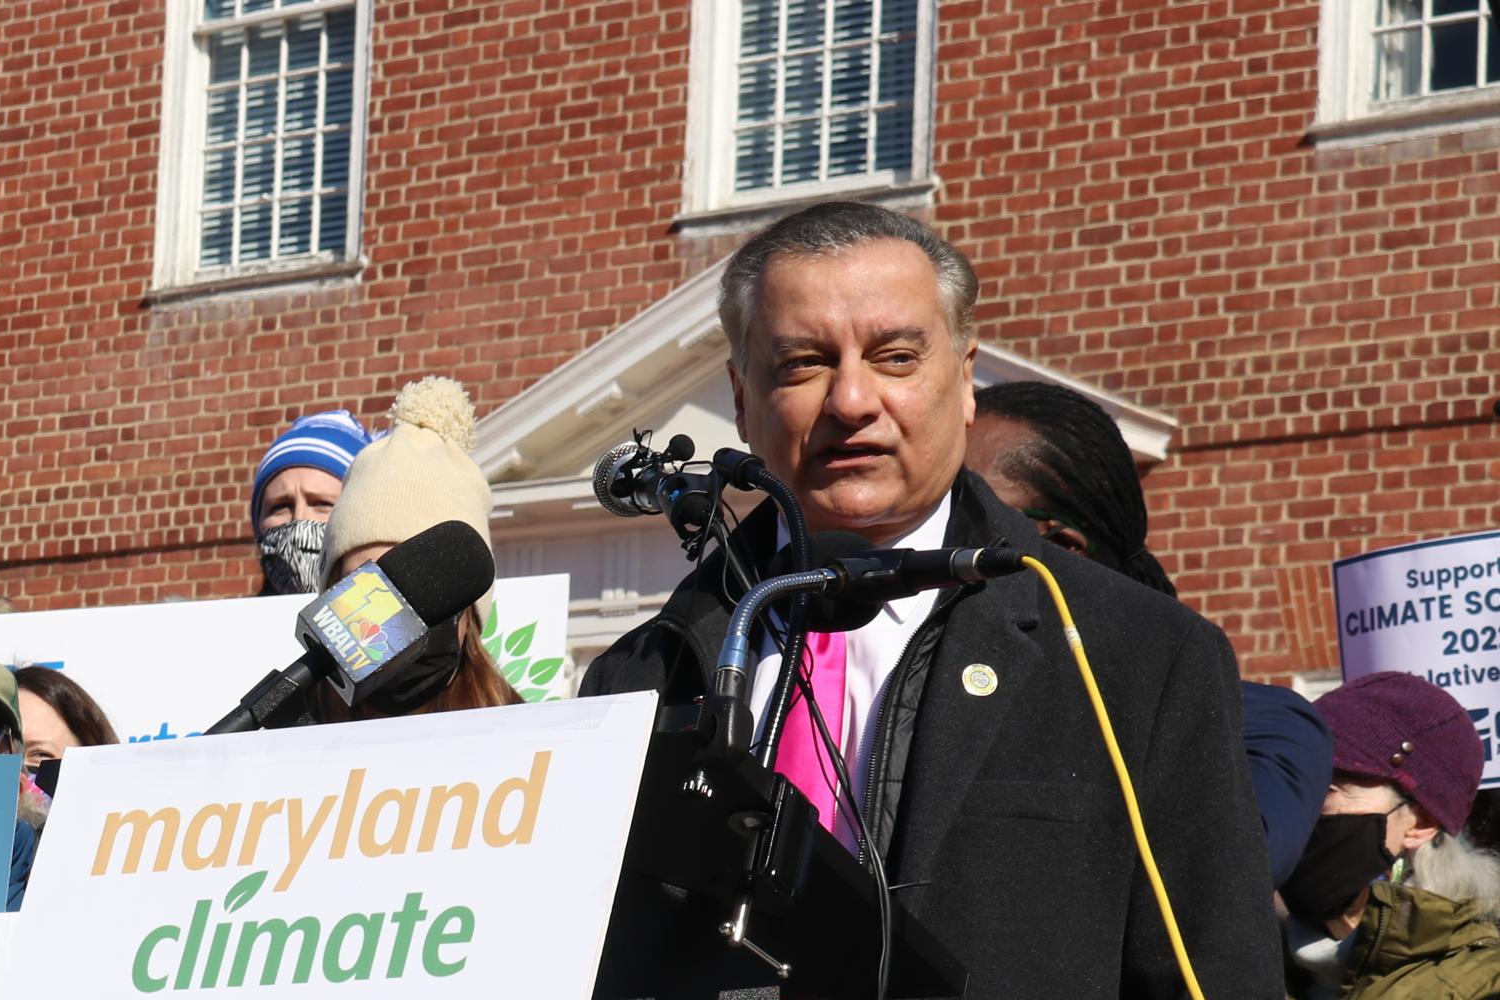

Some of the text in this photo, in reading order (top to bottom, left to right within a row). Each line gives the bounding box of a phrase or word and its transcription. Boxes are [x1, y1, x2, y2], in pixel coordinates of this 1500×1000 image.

[1345, 595, 1453, 637] CLIMATE
[1442, 625, 1500, 656] 202
[1427, 664, 1500, 688] lative
[89, 750, 553, 892] maryland
[131, 871, 476, 994] climate
